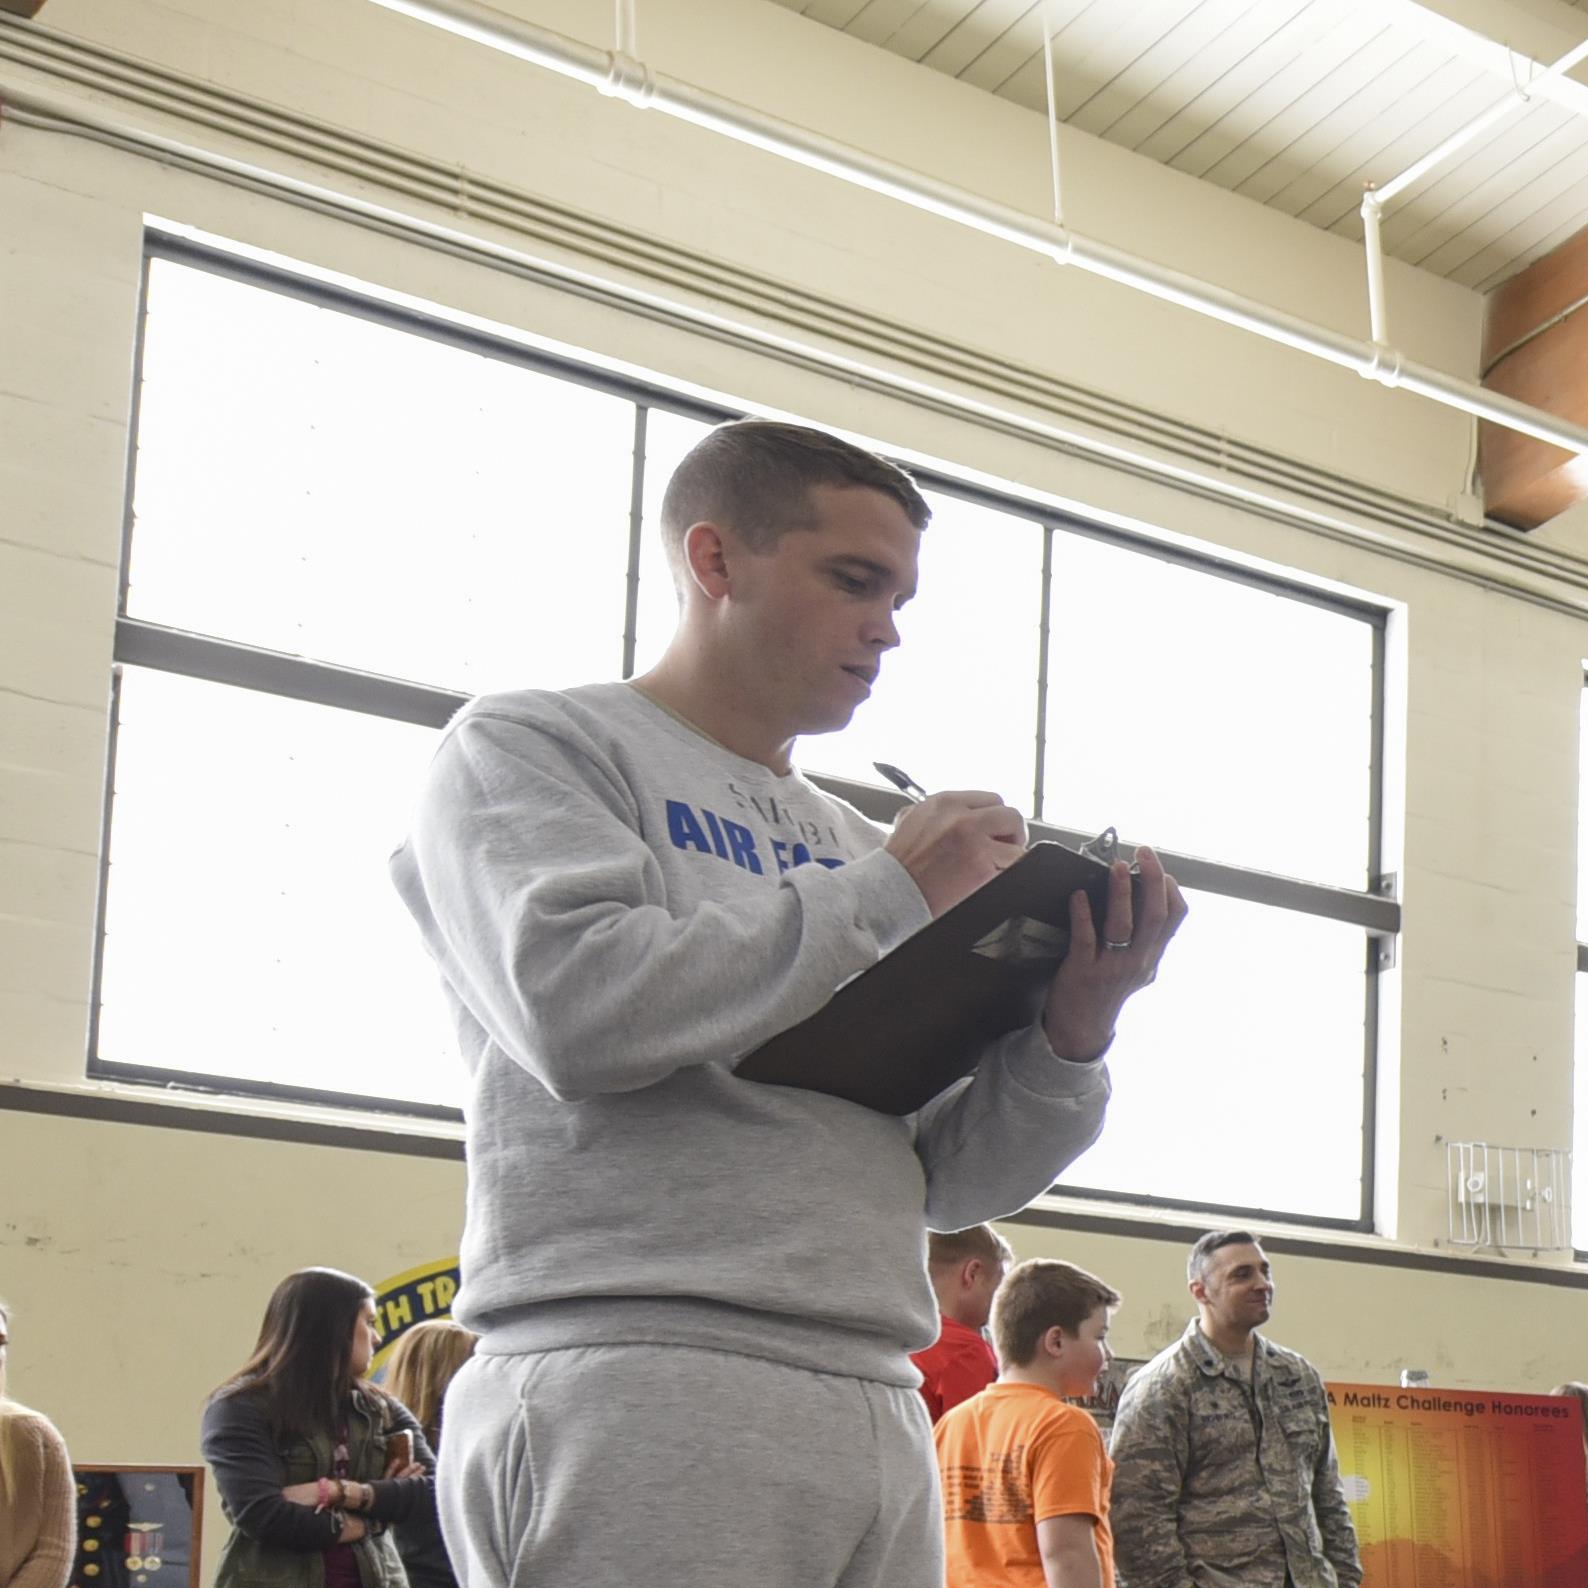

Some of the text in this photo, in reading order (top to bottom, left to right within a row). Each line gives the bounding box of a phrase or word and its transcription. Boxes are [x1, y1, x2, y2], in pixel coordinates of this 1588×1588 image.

[665, 799, 764, 876] AIR
[416, 1275, 456, 1314] TR
[1343, 1391, 1391, 1409] Maltz
[1396, 1393, 1486, 1418] Challenge
[1492, 1400, 1570, 1418] Honorees
